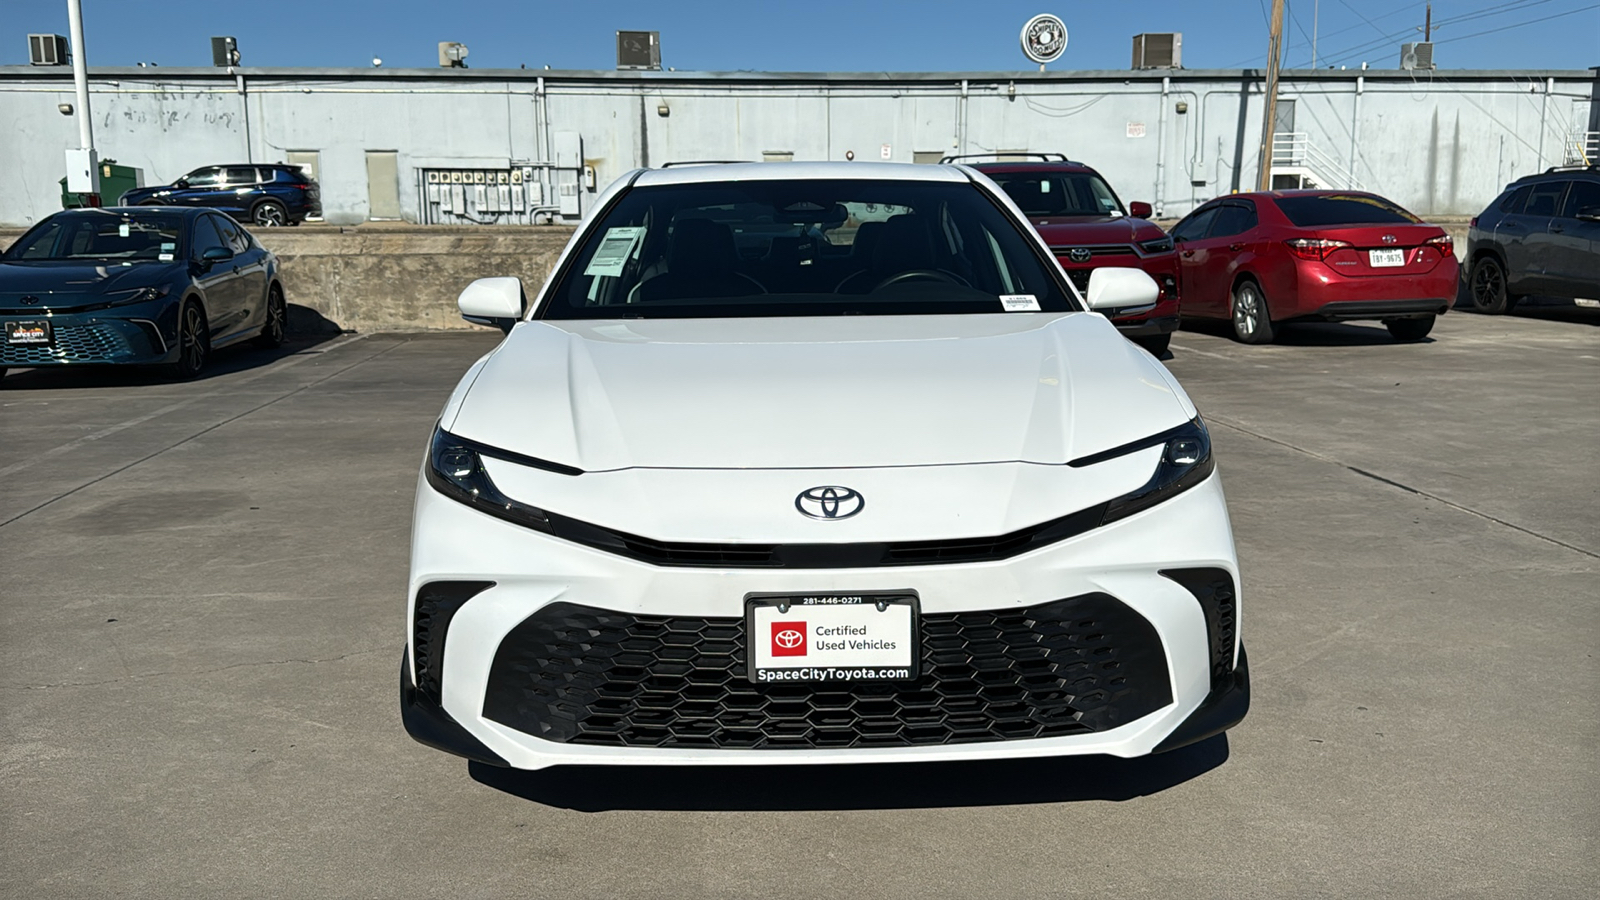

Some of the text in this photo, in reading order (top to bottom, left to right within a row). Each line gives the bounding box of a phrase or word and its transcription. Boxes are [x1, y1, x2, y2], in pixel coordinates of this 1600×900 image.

[816, 626, 867, 636] Certified
[816, 639, 896, 650] Used Vehicles
[758, 668, 909, 682] SpaceCityToyota.com
